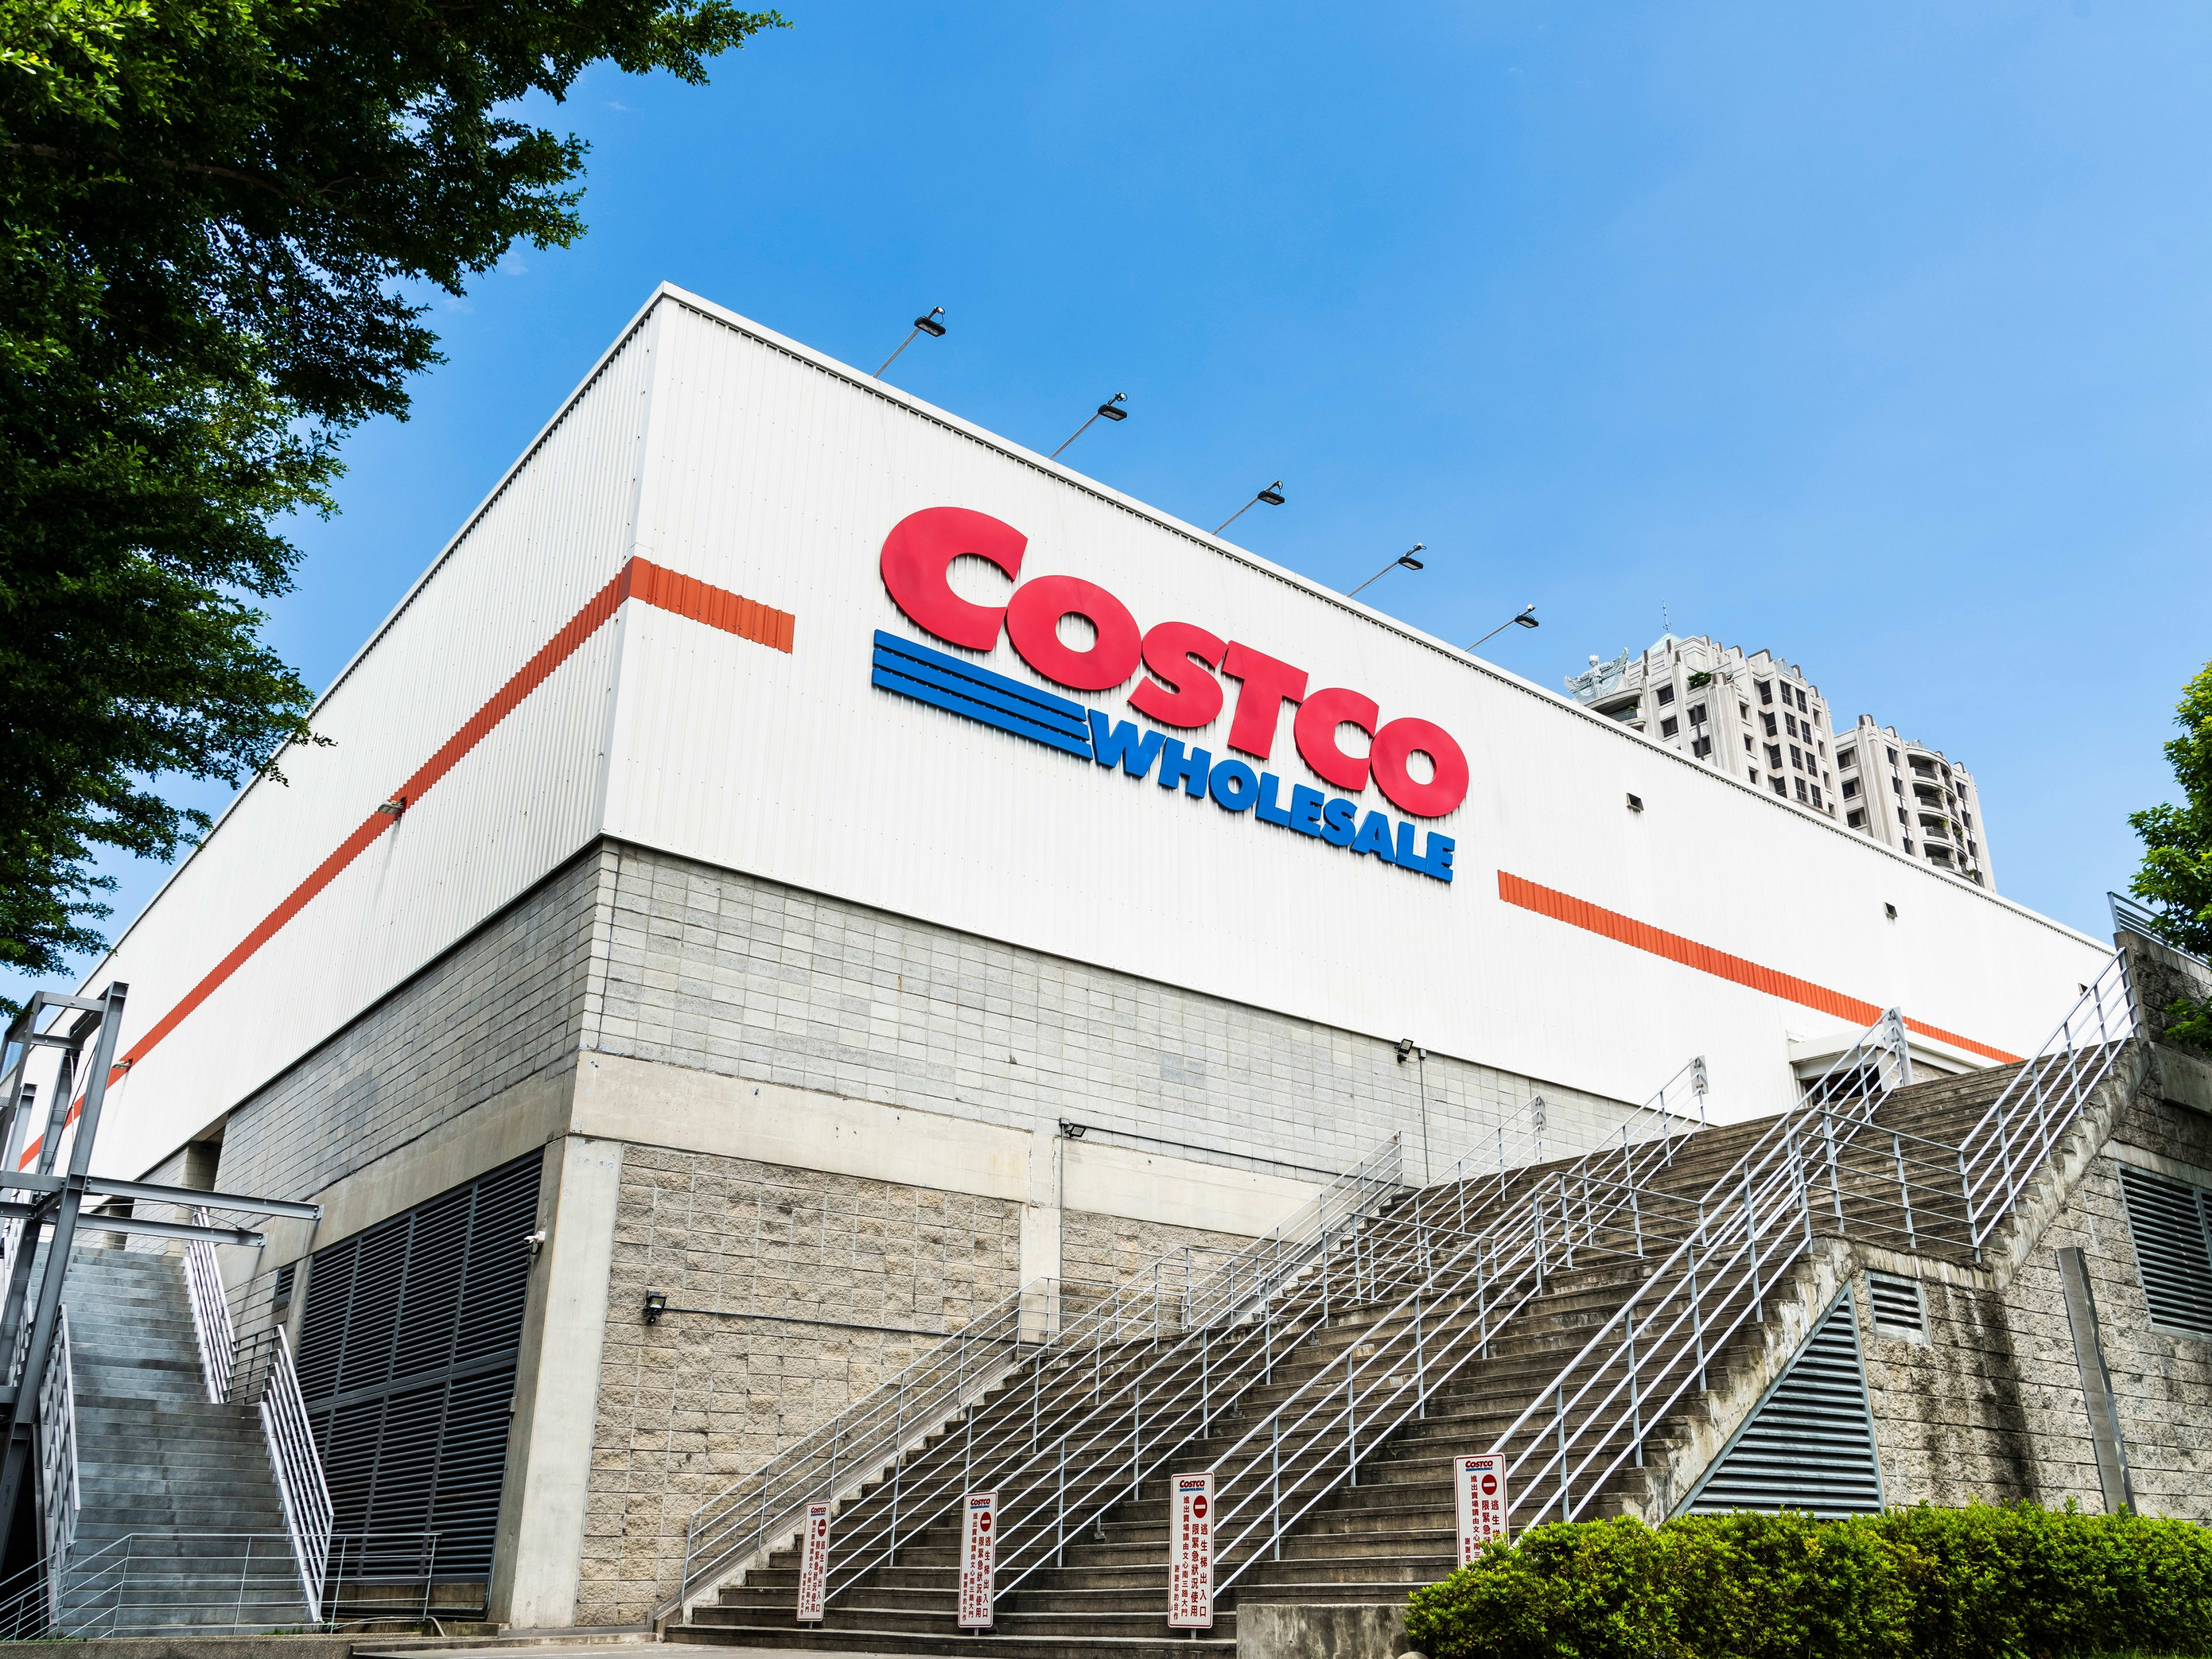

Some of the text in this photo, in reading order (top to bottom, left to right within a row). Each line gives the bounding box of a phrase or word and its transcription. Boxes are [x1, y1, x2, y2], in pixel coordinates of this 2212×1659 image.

[880, 506, 1469, 817] COSTCO
[1088, 709, 1455, 882] WHOLESALE
[1180, 1480, 1205, 1488] COSTCO
[976, 1537, 984, 1618] 限緊急狀況使用
[983, 1536, 991, 1618] 逃生梯出入口
[1181, 1496, 1190, 1616] 進出賣場請由文心南三路大門
[1191, 1524, 1199, 1617] 限緊急狀況使用
[1199, 1524, 1208, 1617] 逃生梯出入口
